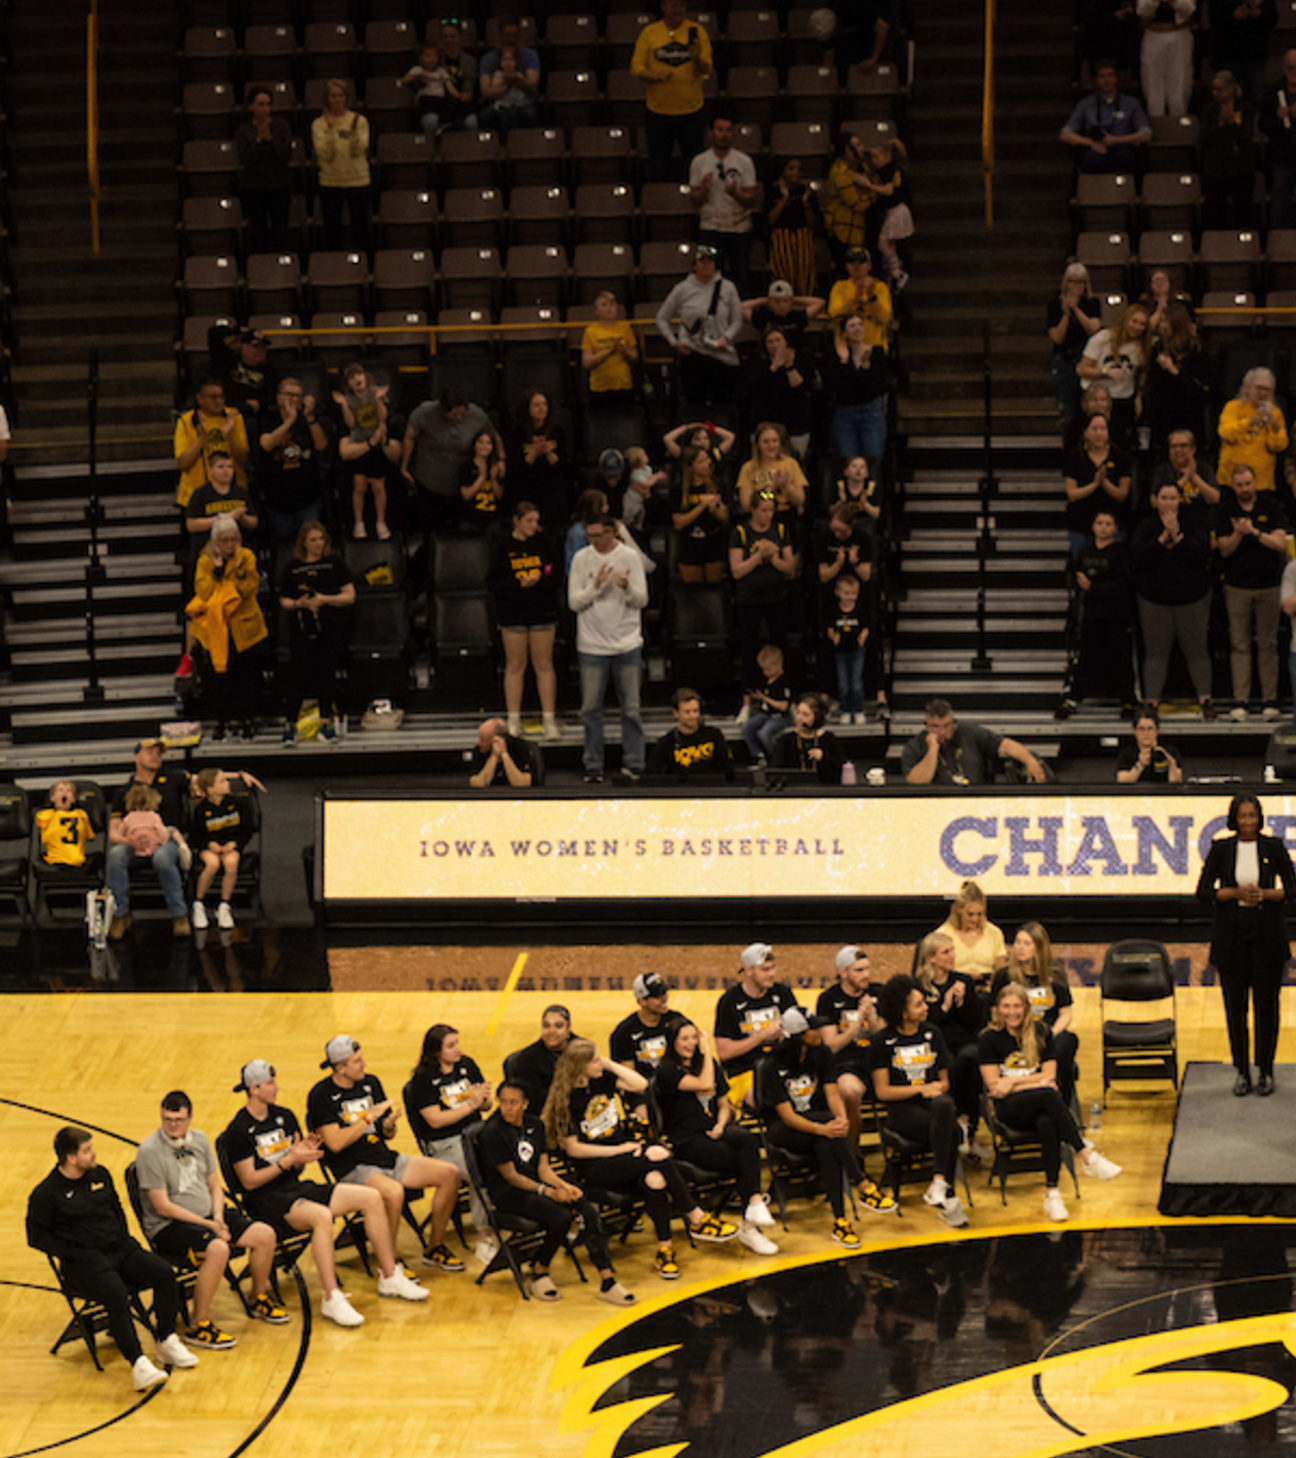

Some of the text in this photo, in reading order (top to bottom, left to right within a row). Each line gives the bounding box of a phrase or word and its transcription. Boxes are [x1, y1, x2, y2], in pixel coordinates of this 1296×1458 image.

[60, 817, 78, 845] 3
[419, 837, 845, 857] IOWA WOMEN'S BASKETBALL
